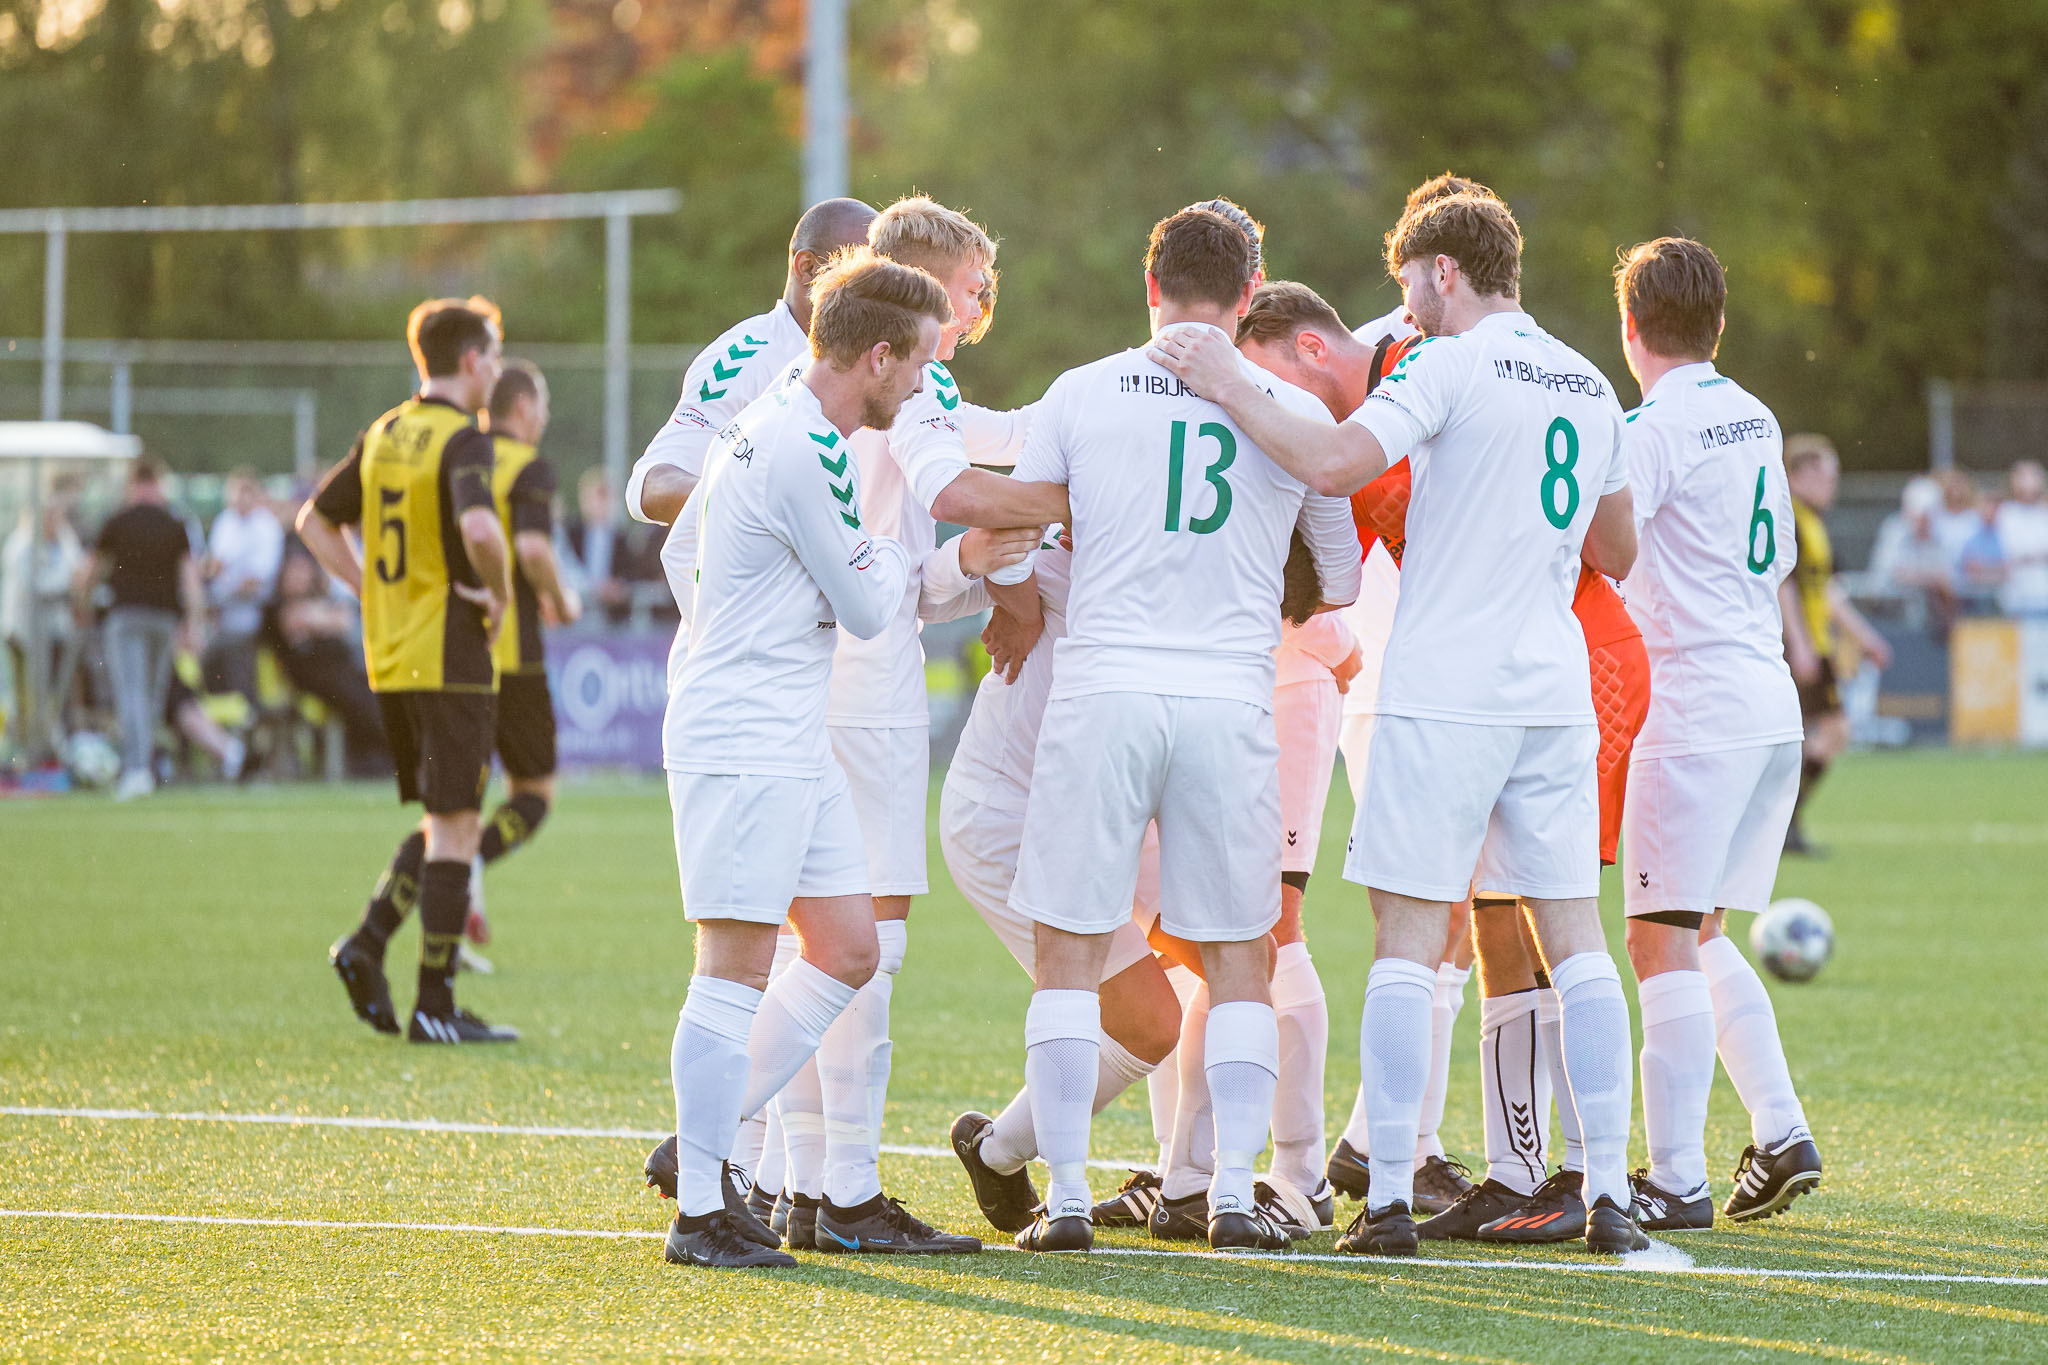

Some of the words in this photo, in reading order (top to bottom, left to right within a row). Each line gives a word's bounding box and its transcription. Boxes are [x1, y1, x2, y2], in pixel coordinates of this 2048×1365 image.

[1164, 420, 1237, 535] 13
[1540, 416, 1580, 530] 8
[1747, 465, 1776, 575] 6
[376, 486, 406, 584] 5
